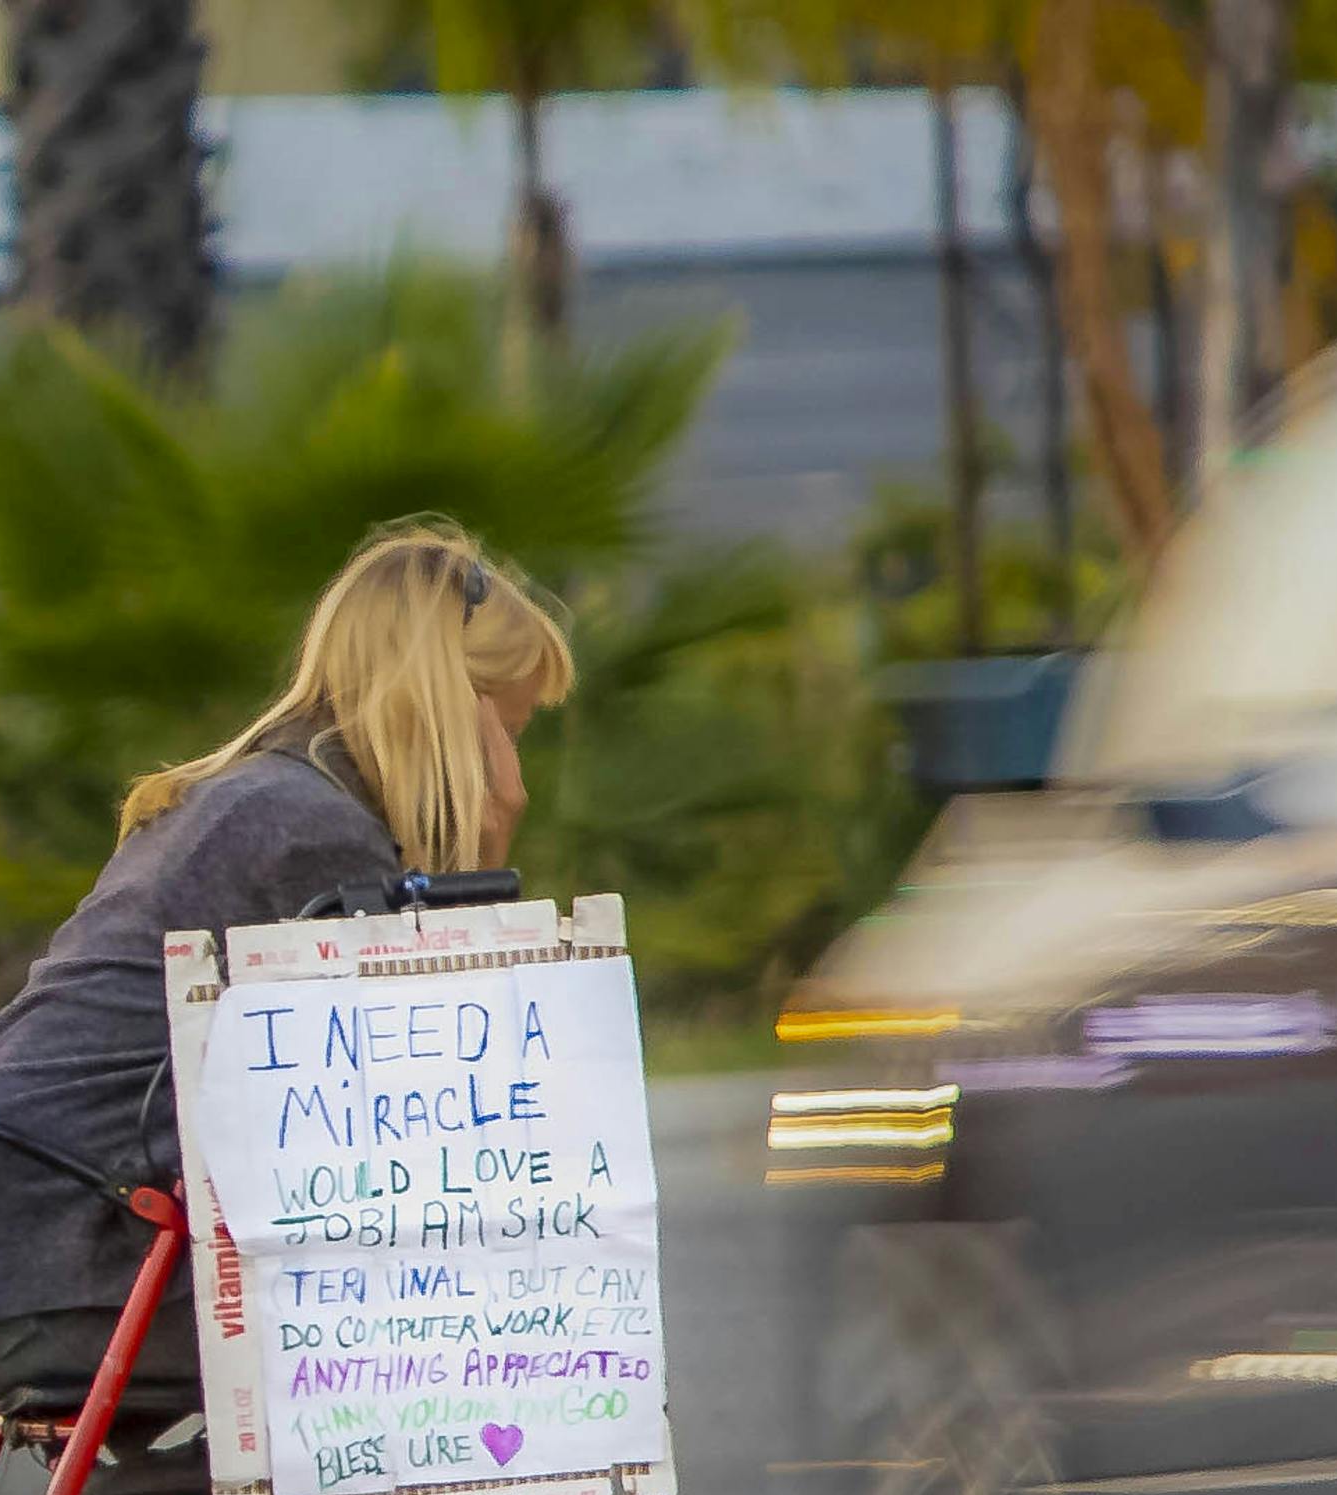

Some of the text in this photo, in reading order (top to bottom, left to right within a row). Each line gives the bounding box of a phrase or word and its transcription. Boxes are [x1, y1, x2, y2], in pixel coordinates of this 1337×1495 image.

[243, 1001, 551, 1071] I NEED A
[273, 1141, 612, 1214] WOULD LOVE A
[422, 1200, 486, 1250] AM
[508, 1266, 566, 1300] BUT
[576, 1265, 646, 1301] CAN
[279, 1323, 323, 1350] DO
[336, 1313, 480, 1348] COMPUTER
[291, 1348, 652, 1398] ANYTHING APPRECIATED
[560, 1384, 630, 1426] GOD
